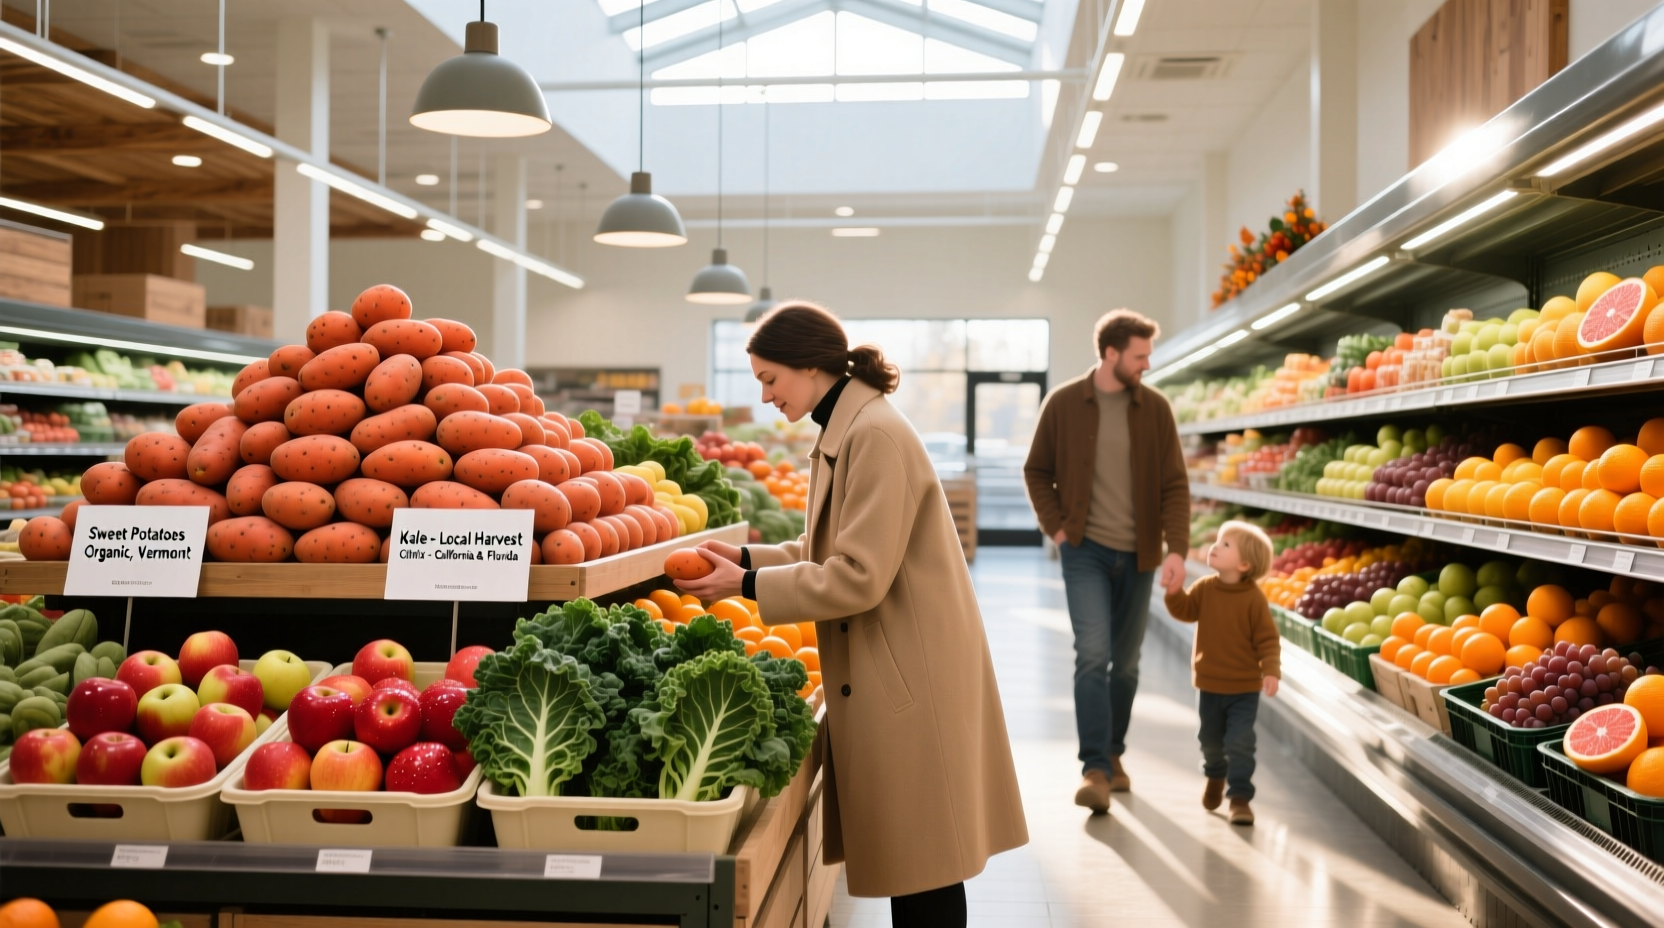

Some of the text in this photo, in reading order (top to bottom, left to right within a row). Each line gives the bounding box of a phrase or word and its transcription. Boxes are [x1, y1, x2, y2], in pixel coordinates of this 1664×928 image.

[88, 526, 186, 541] Sweet Potatoes
[399, 529, 428, 545] Kale
[439, 531, 472, 546] Local
[474, 531, 523, 547] Harvest
[84, 544, 192, 562] Organic, Vermont
[476, 550, 484, 561] &
